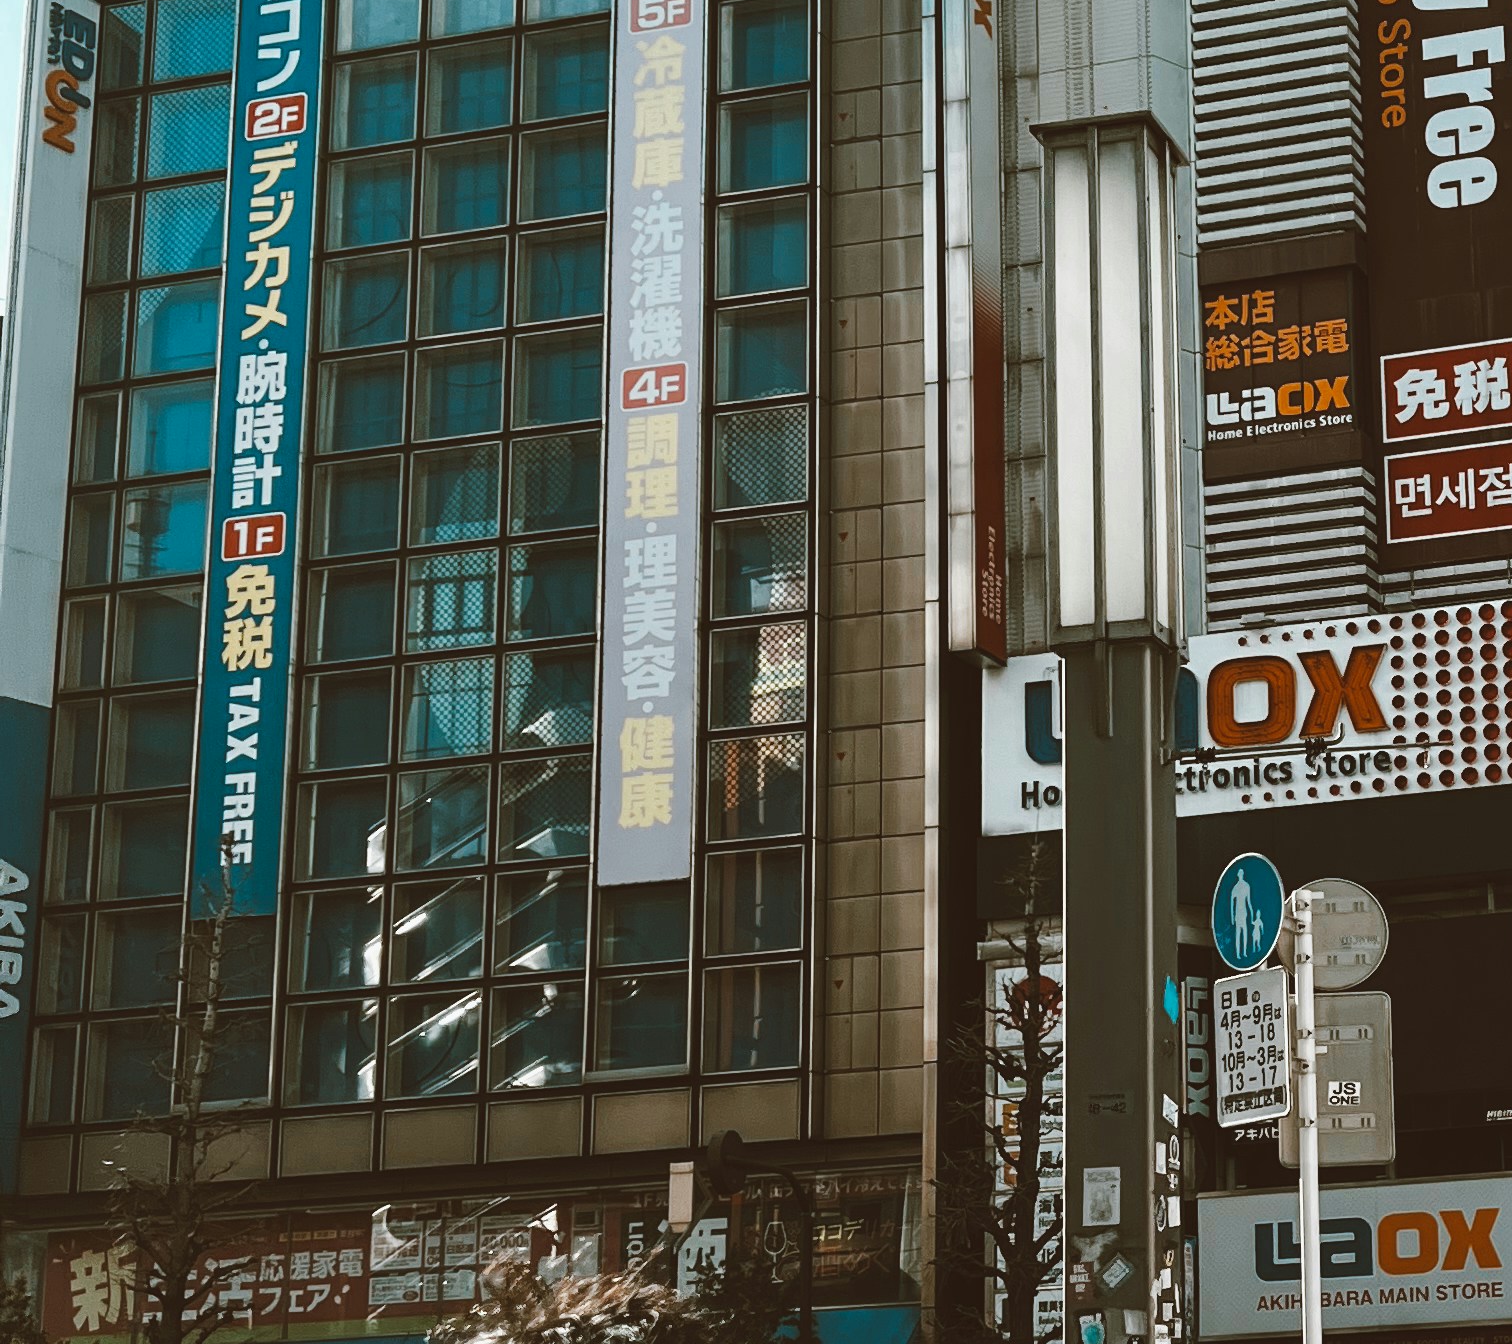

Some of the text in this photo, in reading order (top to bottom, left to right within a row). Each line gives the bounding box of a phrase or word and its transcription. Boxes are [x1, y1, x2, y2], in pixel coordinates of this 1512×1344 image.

[1377, 18, 1412, 129] Store
[253, 102, 299, 136] 2F
[1422, 25, 1505, 209] Free
[628, 35, 686, 361] 冷蔵庫・洗濯機
[231, 140, 298, 510] デジカメ・腕時計
[1205, 289, 1275, 331] 本店
[1205, 319, 1349, 372] 総合家電
[628, 370, 681, 404] 4F
[1394, 357, 1511, 424] 免税
[1208, 413, 1353, 441] Home Electronics Store
[234, 521, 275, 556] 1F
[222, 564, 276, 672] 免税
[220, 677, 261, 867] TAX FREE
[1021, 780, 1062, 810] Ho
[1305, 749, 1392, 779] Store
[1329, 1095, 1360, 1106] ONE
[1332, 1082, 1357, 1095] JS
[260, 1248, 363, 1282] 応援家電
[1256, 1281, 1504, 1312] AKIHBARA MAIN STORE
